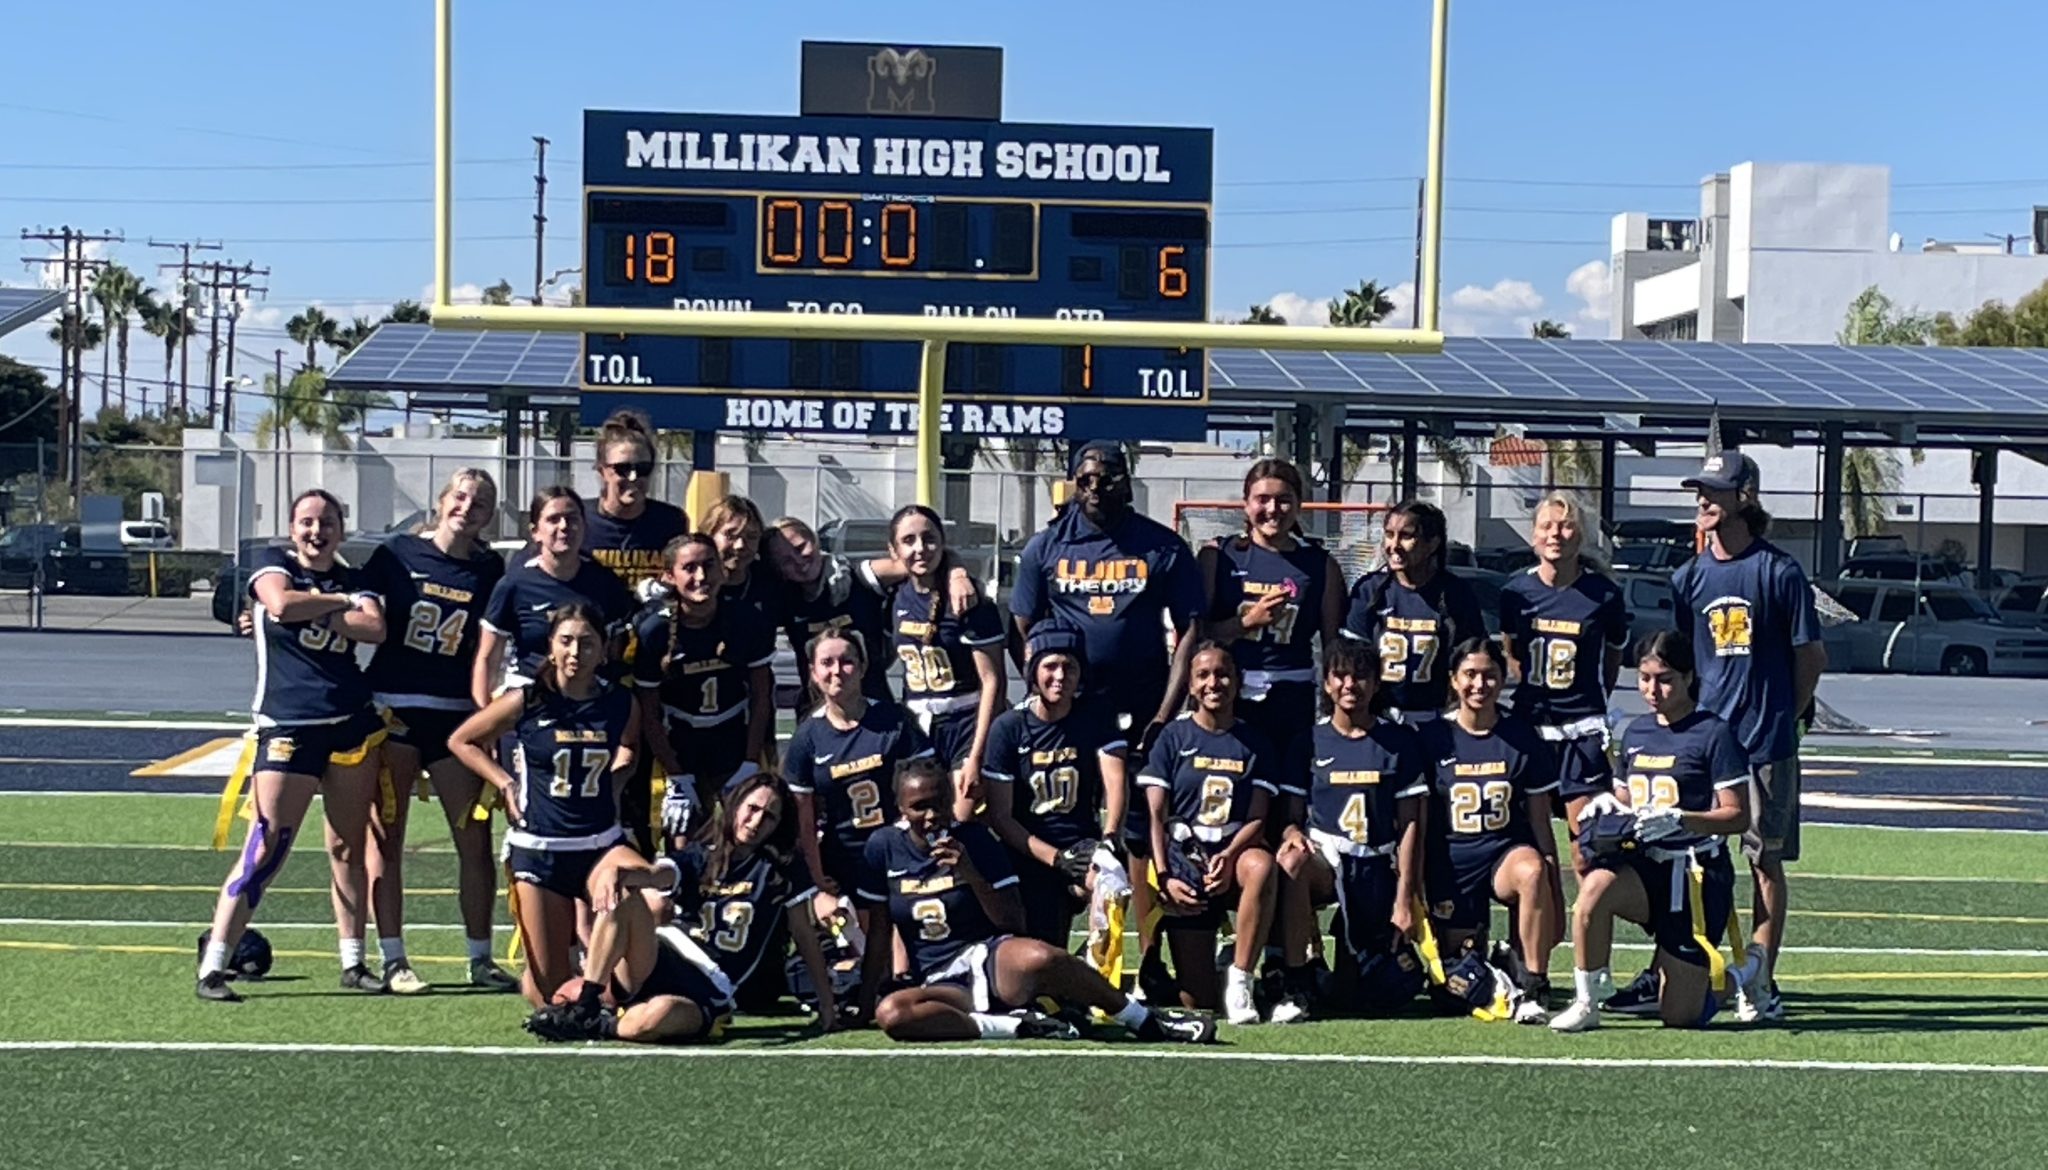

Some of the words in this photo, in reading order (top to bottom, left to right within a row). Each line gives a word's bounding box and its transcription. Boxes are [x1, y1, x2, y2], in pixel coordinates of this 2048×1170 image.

[626, 130, 861, 175] MILLIKAN
[873, 138, 984, 178] HIGH
[996, 141, 1171, 183] SCHOOL
[625, 231, 674, 283] 18
[1159, 246, 1187, 297] 6
[589, 354, 652, 385] T.O.L.
[1138, 368, 1201, 398] T.O.L.
[726, 398, 825, 429] HOME
[832, 401, 877, 430] OF
[962, 404, 1065, 435] RAMS
[404, 600, 469, 656] 24
[1379, 631, 1440, 683] 27
[1527, 637, 1577, 690] 18
[699, 676, 719, 713] 1
[550, 748, 611, 798] 17
[1029, 766, 1079, 815] 10
[846, 779, 885, 829] 2
[1338, 792, 1369, 844] 4
[1449, 781, 1513, 833] 23
[912, 898, 952, 941] 3
